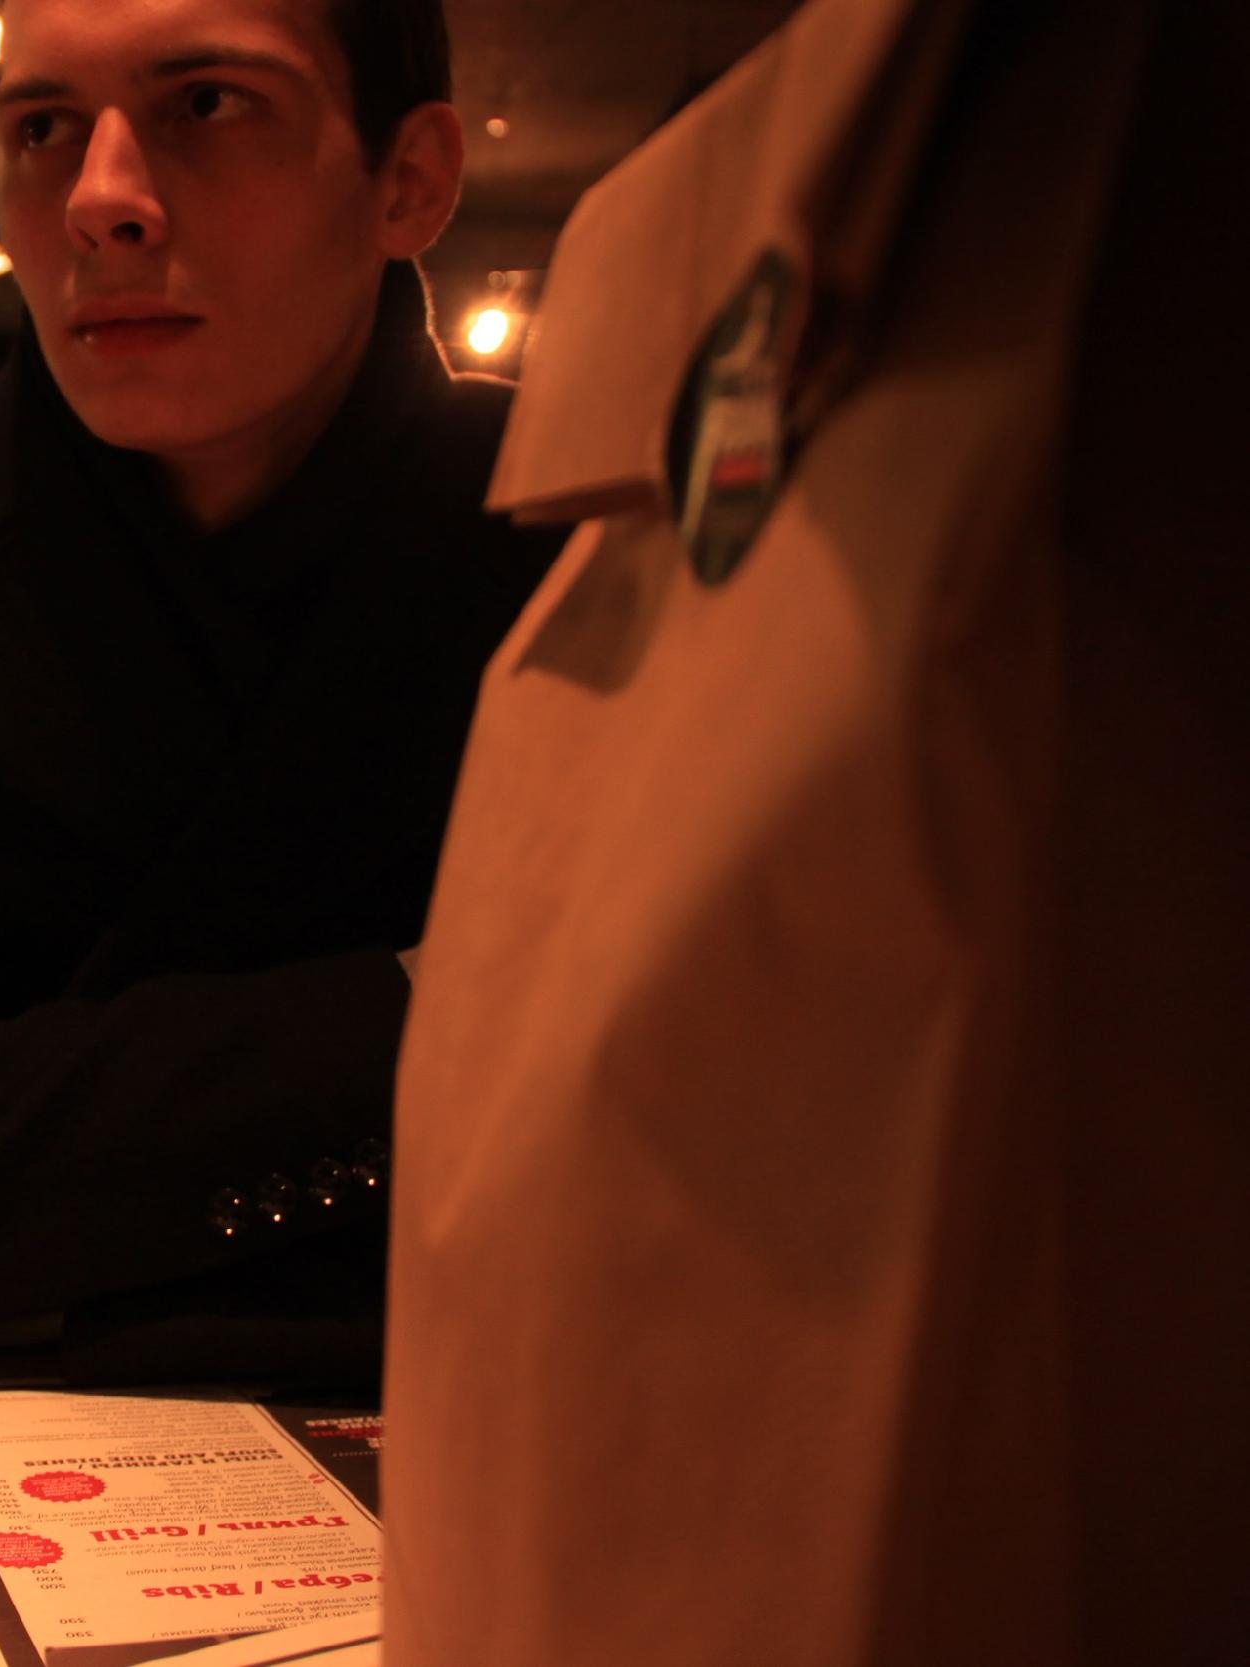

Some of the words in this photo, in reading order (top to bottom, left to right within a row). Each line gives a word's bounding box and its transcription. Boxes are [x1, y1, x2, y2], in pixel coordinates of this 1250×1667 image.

[214, 1448, 278, 1457] SOUPS
[24, 1457, 102, 1466] DISHES
[92, 1460, 194, 1468] ГАРНИРЫ
[217, 1516, 349, 1530] Гриль
[90, 1526, 189, 1542] Grill
[271, 1573, 386, 1589] ебра
[142, 1583, 244, 1599] Ribs
